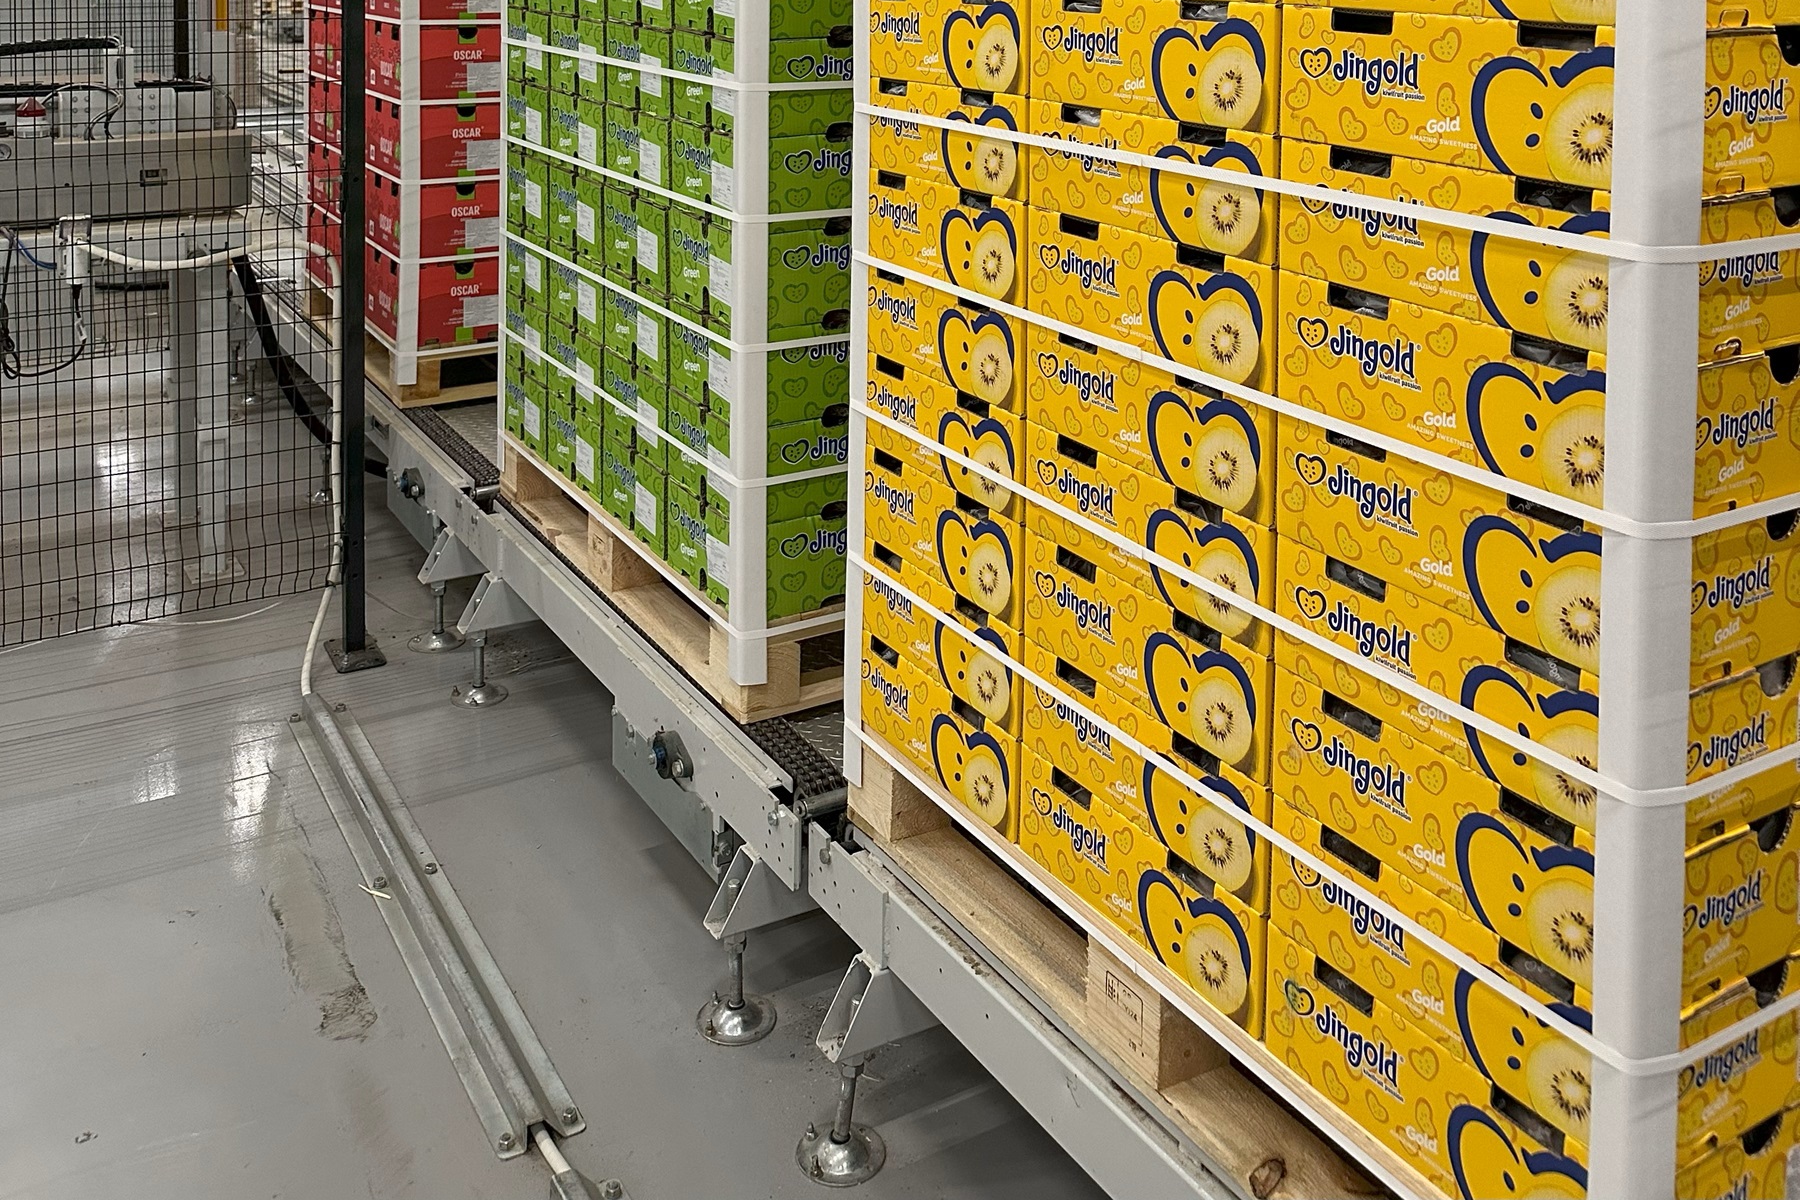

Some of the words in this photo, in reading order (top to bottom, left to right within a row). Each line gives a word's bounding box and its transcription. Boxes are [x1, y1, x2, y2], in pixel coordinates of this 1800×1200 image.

[881, 12, 919, 41] Jingold
[454, 50, 482, 60] OSCAR
[1064, 28, 1119, 62] Jingold
[1124, 77, 1145, 90] Gold
[1333, 52, 1419, 97] Jingold
[1405, 92, 1425, 101] passion
[1723, 80, 1783, 124] Jingold
[453, 128, 480, 138] OSCAR
[1426, 117, 1460, 134] Gold
[1410, 134, 1438, 144] AMAZING
[1439, 138, 1478, 150] SWEETNESS
[1729, 133, 1754, 156] Gold
[452, 207, 480, 217] OSCAR
[1122, 192, 1143, 204] Gold
[879, 198, 917, 228] Jingold
[1062, 252, 1116, 289] Jingold
[1426, 266, 1459, 282] Gold
[451, 285, 479, 296] OSCAR
[878, 290, 915, 322] Jingold
[1121, 314, 1142, 326] Gold
[1725, 297, 1750, 320] Gold
[1330, 326, 1415, 378] Jingold
[1060, 361, 1114, 401] Jingold
[878, 387, 915, 420] Jingold
[1423, 412, 1456, 429] Gold
[1713, 399, 1773, 448] Jingold
[1120, 430, 1141, 442] Gold
[1719, 456, 1744, 482] Gold
[875, 478, 913, 516] Jingold
[1059, 470, 1113, 512] Jingold
[1328, 466, 1412, 525] Jingold
[1420, 558, 1453, 578] Gold
[1709, 557, 1770, 608] Jingold
[1058, 584, 1111, 634] Jingold
[1328, 602, 1411, 667] Jingold
[1714, 618, 1740, 644] Gold
[1116, 664, 1138, 680] Gold
[872, 668, 908, 713] Jingold
[1704, 713, 1764, 766] Jingold
[1324, 737, 1405, 808] Jingold
[1053, 805, 1106, 864] Jingold
[1413, 844, 1446, 868] Gold
[1699, 871, 1761, 928] Jingold
[1412, 988, 1444, 1014] Gold
[1316, 1006, 1398, 1088] Jingold
